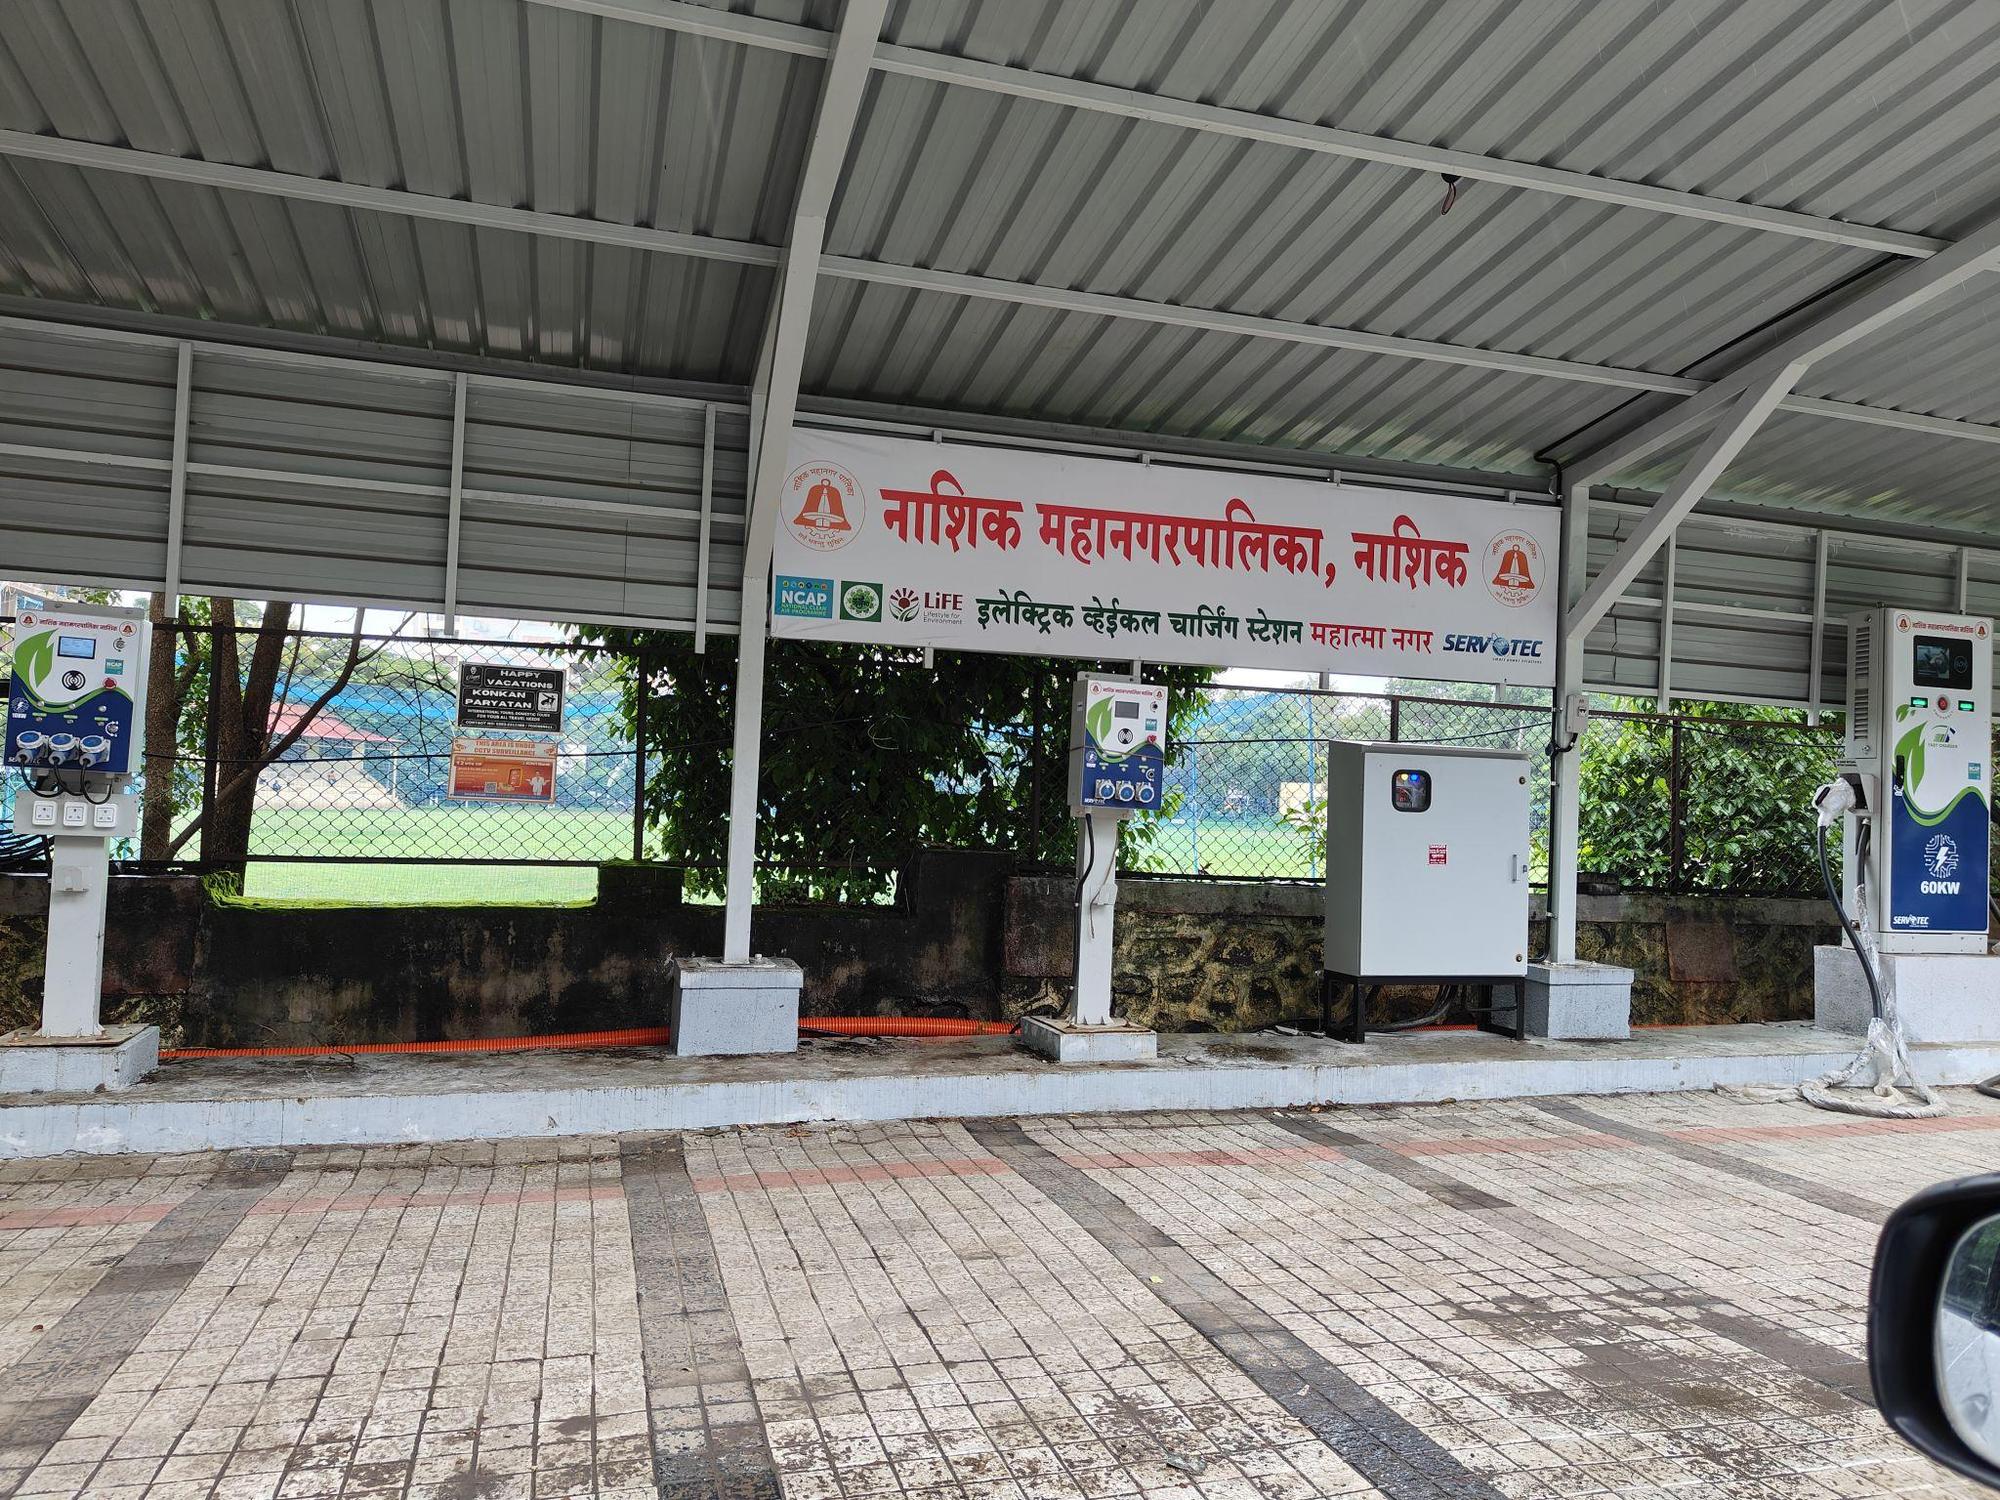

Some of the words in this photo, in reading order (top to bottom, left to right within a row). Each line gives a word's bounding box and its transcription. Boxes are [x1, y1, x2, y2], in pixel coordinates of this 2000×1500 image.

[879, 469, 1023, 553] नाशिक
[1035, 497, 1337, 589] महानगरपालिका,
[1351, 514, 1470, 590] नाशिक
[781, 590, 828, 606] NCAP
[924, 591, 964, 611] LiFE
[923, 611, 950, 620] Lifestyle
[975, 589, 1074, 634] इलेक्ट्रिक
[1081, 595, 1161, 639] व्हेईकल
[1167, 604, 1239, 640] चार्जिंग
[1245, 608, 1303, 644] स्टेशन
[1309, 622, 1387, 651] महात्मा
[1391, 628, 1434, 654] नगर
[500, 670, 541, 679] HAPPY
[486, 678, 554, 689] VACATIONS
[472, 689, 526, 699] KONKAN
[465, 698, 532, 709] PARYATAN
[1920, 880, 1960, 894] 60KW
